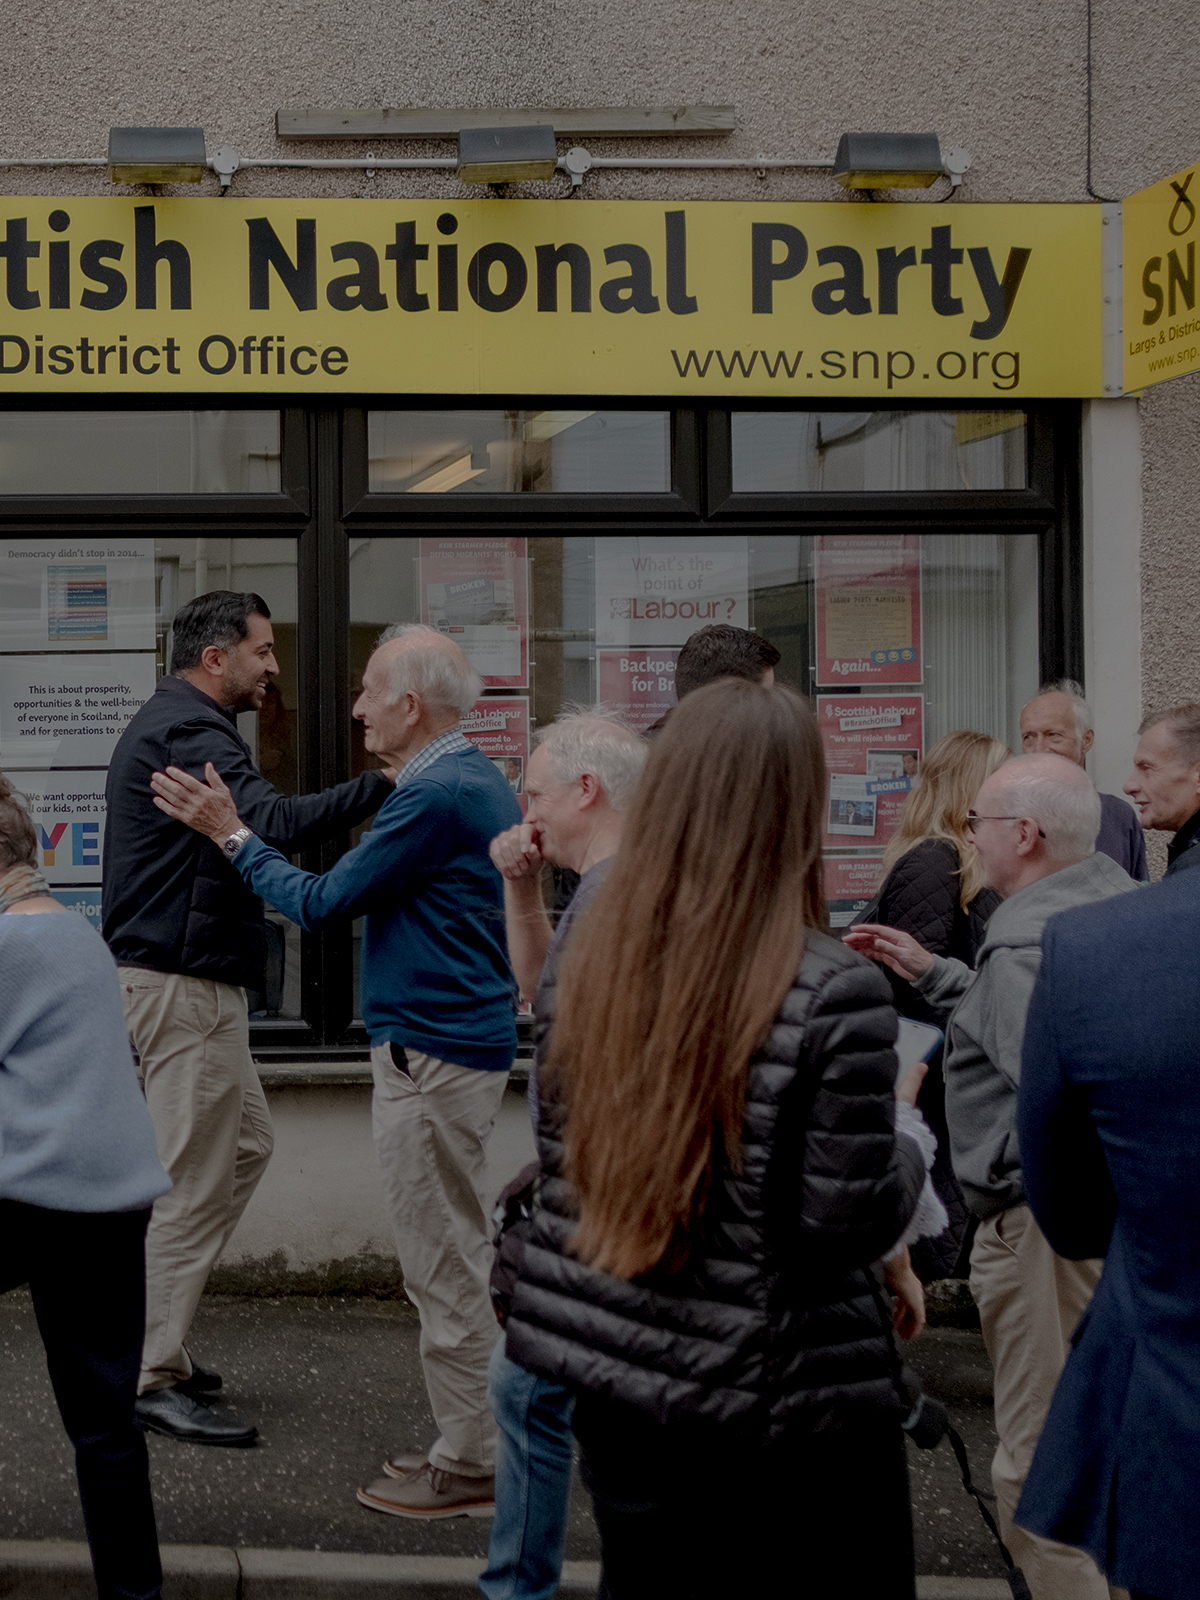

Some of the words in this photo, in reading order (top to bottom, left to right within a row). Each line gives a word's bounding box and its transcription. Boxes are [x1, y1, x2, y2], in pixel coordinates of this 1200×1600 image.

[245, 210, 698, 314] National
[752, 222, 1032, 340] Party
[1130, 337, 1156, 355] Largs
[1159, 330, 1166, 345] &
[198, 334, 349, 375] Office
[670, 349, 1021, 390] www.snp.org
[8, 550, 56, 559] Democracy
[58, 549, 84, 558] didn't
[86, 550, 105, 559] stop
[107, 548, 115, 557] in
[117, 549, 145, 559] 2014...
[632, 556, 684, 571] What's
[688, 556, 714, 571] the
[449, 579, 486, 594] BROKEN
[644, 575, 683, 593] point
[687, 575, 704, 590] of
[831, 658, 882, 675] Again...
[28, 685, 46, 694] This
[48, 685, 56, 694] is
[58, 685, 83, 694] about
[85, 684, 132, 695] prosperity,
[631, 676, 654, 692] for
[13, 699, 72, 709] opportunities
[74, 699, 82, 707] &
[84, 699, 98, 707] the
[101, 698, 145, 708] well-being
[484, 709, 521, 719] Labour
[834, 706, 877, 717] Scottish
[879, 705, 916, 716] Labour
[17, 713, 27, 722] of
[28, 714, 69, 723] everyone
[71, 712, 79, 721] in
[81, 712, 122, 722] Scotland,
[844, 716, 897, 727] #BranchOffice
[20, 727, 36, 736] and
[38, 727, 51, 735] for
[53, 727, 103, 737] generations
[106, 727, 115, 735] to
[471, 735, 502, 744] opposed
[847, 734, 861, 743] will
[862, 734, 883, 743] rejoin
[885, 734, 896, 742] the
[870, 781, 906, 792] BROKEN
[53, 804, 74, 813] kids,
[76, 804, 91, 812] not
[34, 822, 100, 866] YE
